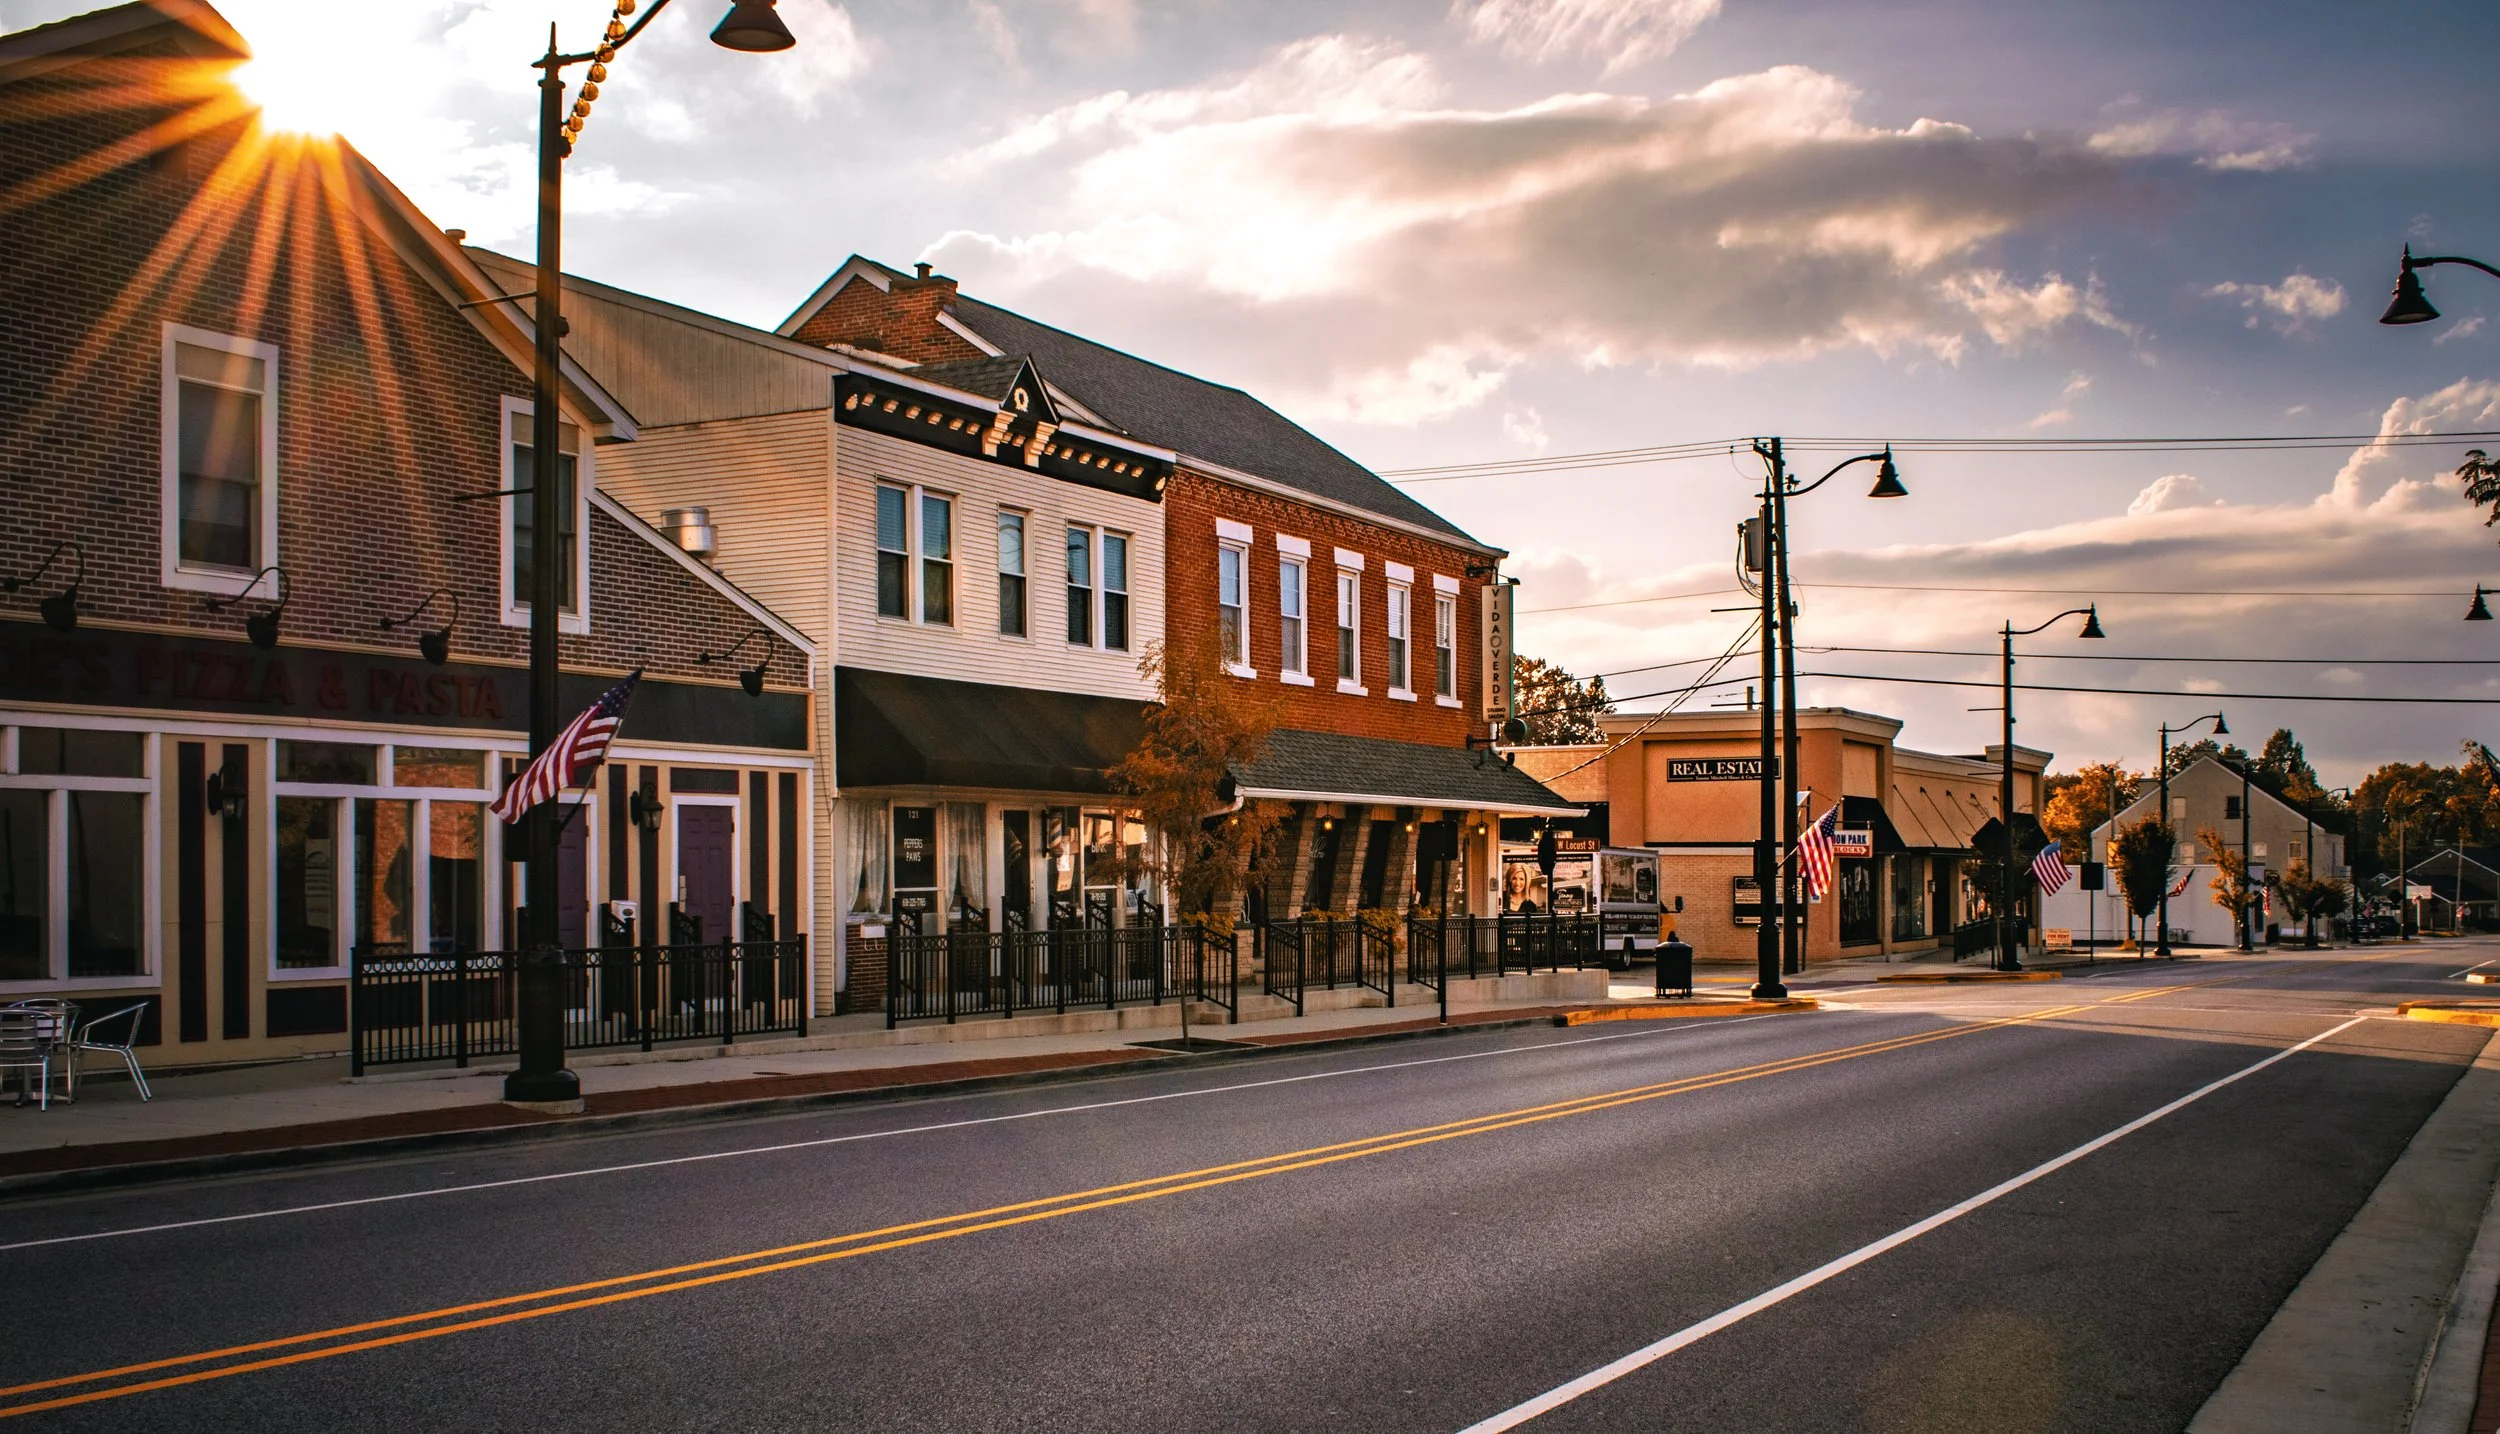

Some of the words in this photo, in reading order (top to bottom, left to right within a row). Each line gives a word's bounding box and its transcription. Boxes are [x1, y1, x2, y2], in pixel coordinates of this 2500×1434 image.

[1491, 588, 1500, 634] VIDA
[136, 647, 296, 706] PIZZA
[319, 665, 348, 710] &
[369, 668, 503, 721] PASTA
[1491, 649, 1500, 706] VERDE
[1672, 762, 1713, 776] REAL
[1716, 760, 1762, 775] ESTAT
[908, 810, 919, 819] 121
[1557, 840, 1564, 850] W
[1565, 840, 1586, 850] Locust
[1588, 840, 1595, 850] St
[1848, 834, 1867, 844] PARK
[906, 852, 921, 862] PAWS
